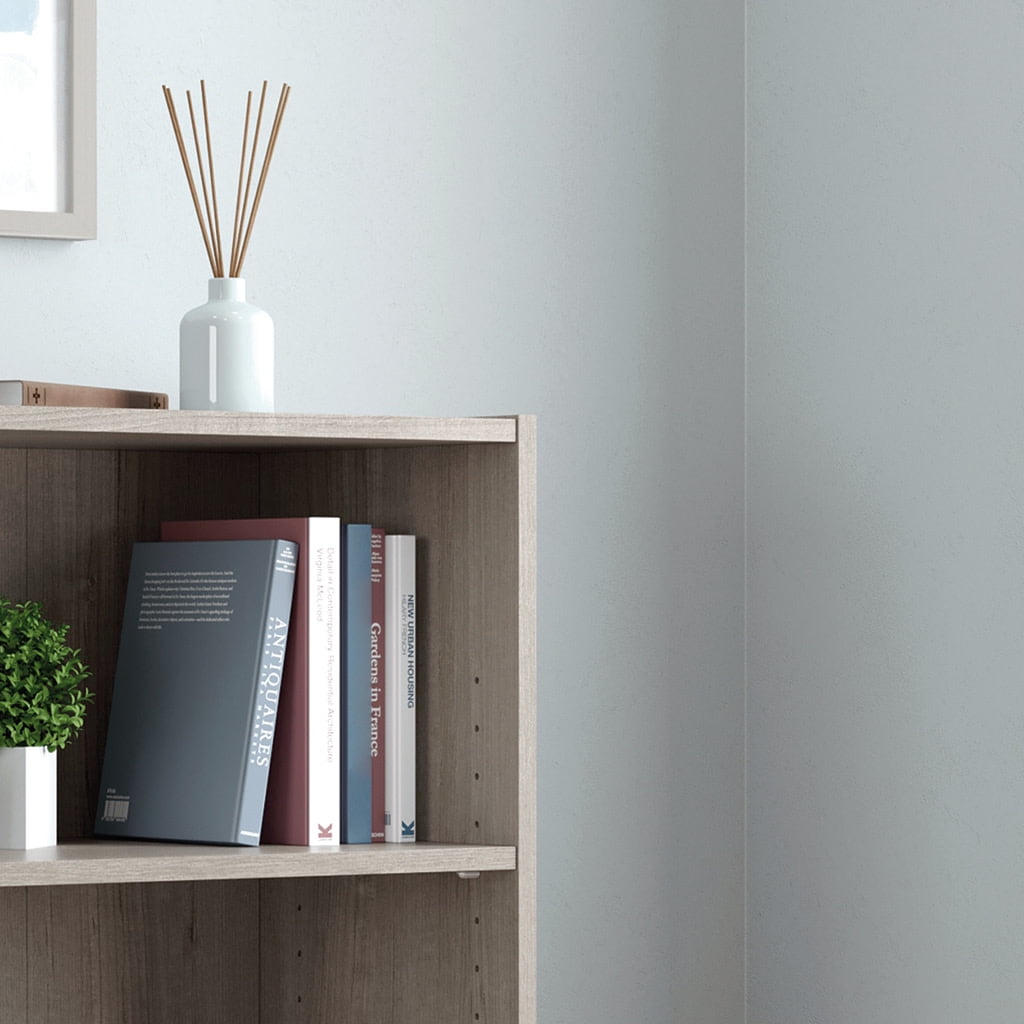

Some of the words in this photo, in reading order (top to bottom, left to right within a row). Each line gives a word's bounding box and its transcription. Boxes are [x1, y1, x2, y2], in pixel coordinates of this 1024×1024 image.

[407, 594, 415, 618] NEW
[371, 623, 381, 684] Gardens
[407, 621, 415, 657] URBAN
[256, 617, 287, 767] ANTIQUAIRES
[371, 688, 381, 702] in
[407, 660, 415, 709] HOUSING
[371, 706, 382, 757] France
